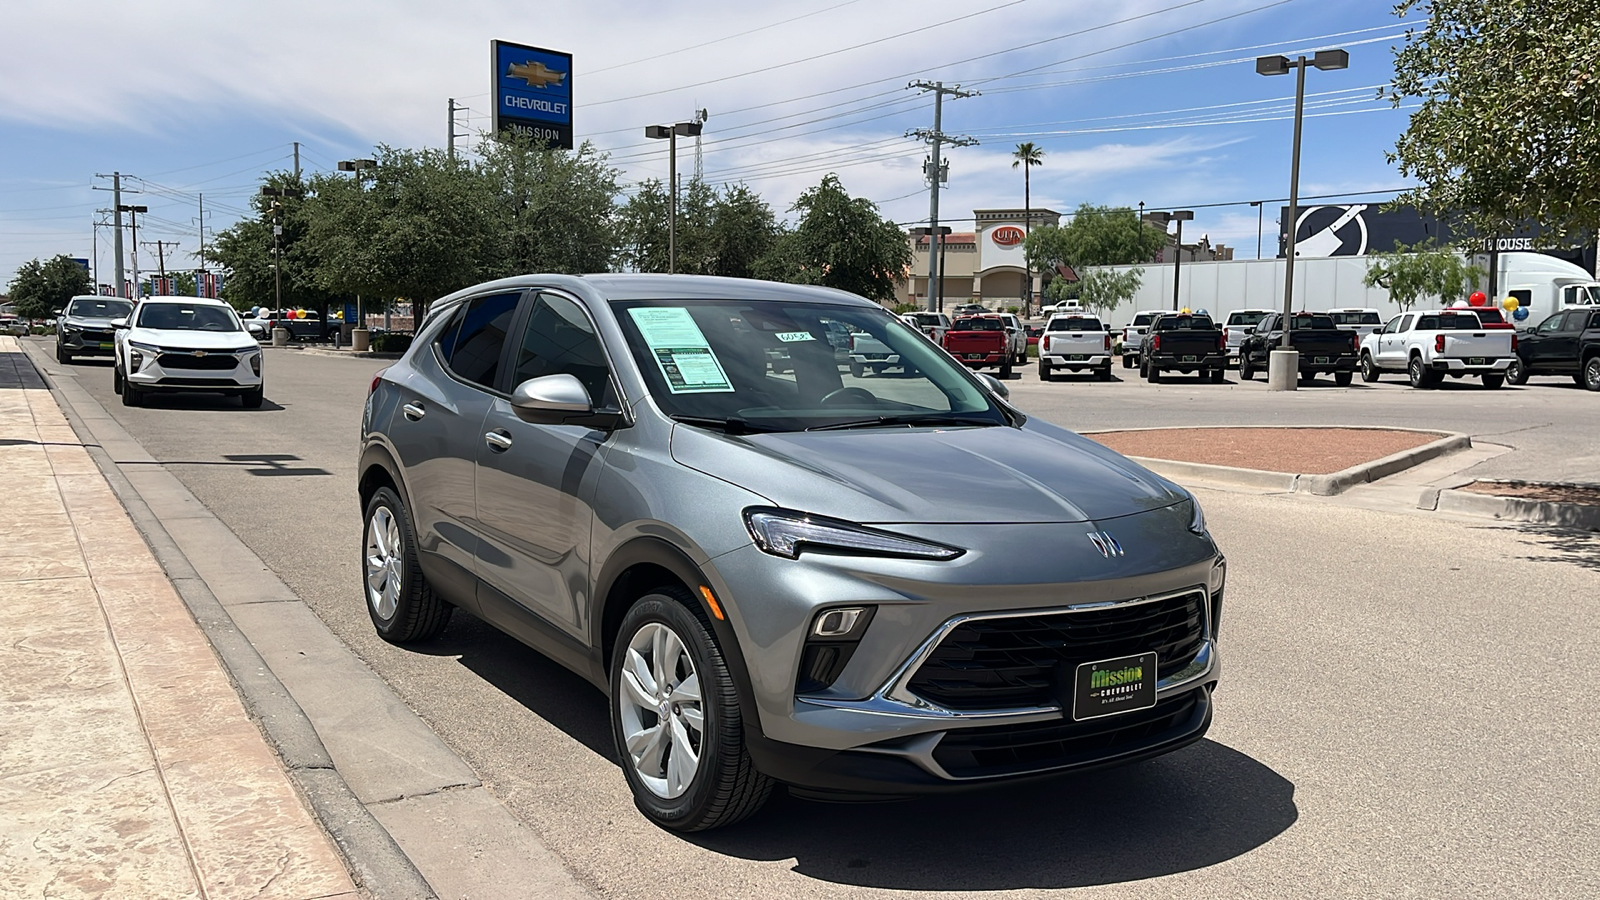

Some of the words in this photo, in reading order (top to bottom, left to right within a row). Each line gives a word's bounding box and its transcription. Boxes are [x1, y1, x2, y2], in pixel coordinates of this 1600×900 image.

[505, 95, 567, 114] CHEVROLET
[513, 123, 559, 140] MISSION
[1090, 665, 1143, 689] Mission
[1100, 683, 1143, 697] CHEVROLET
